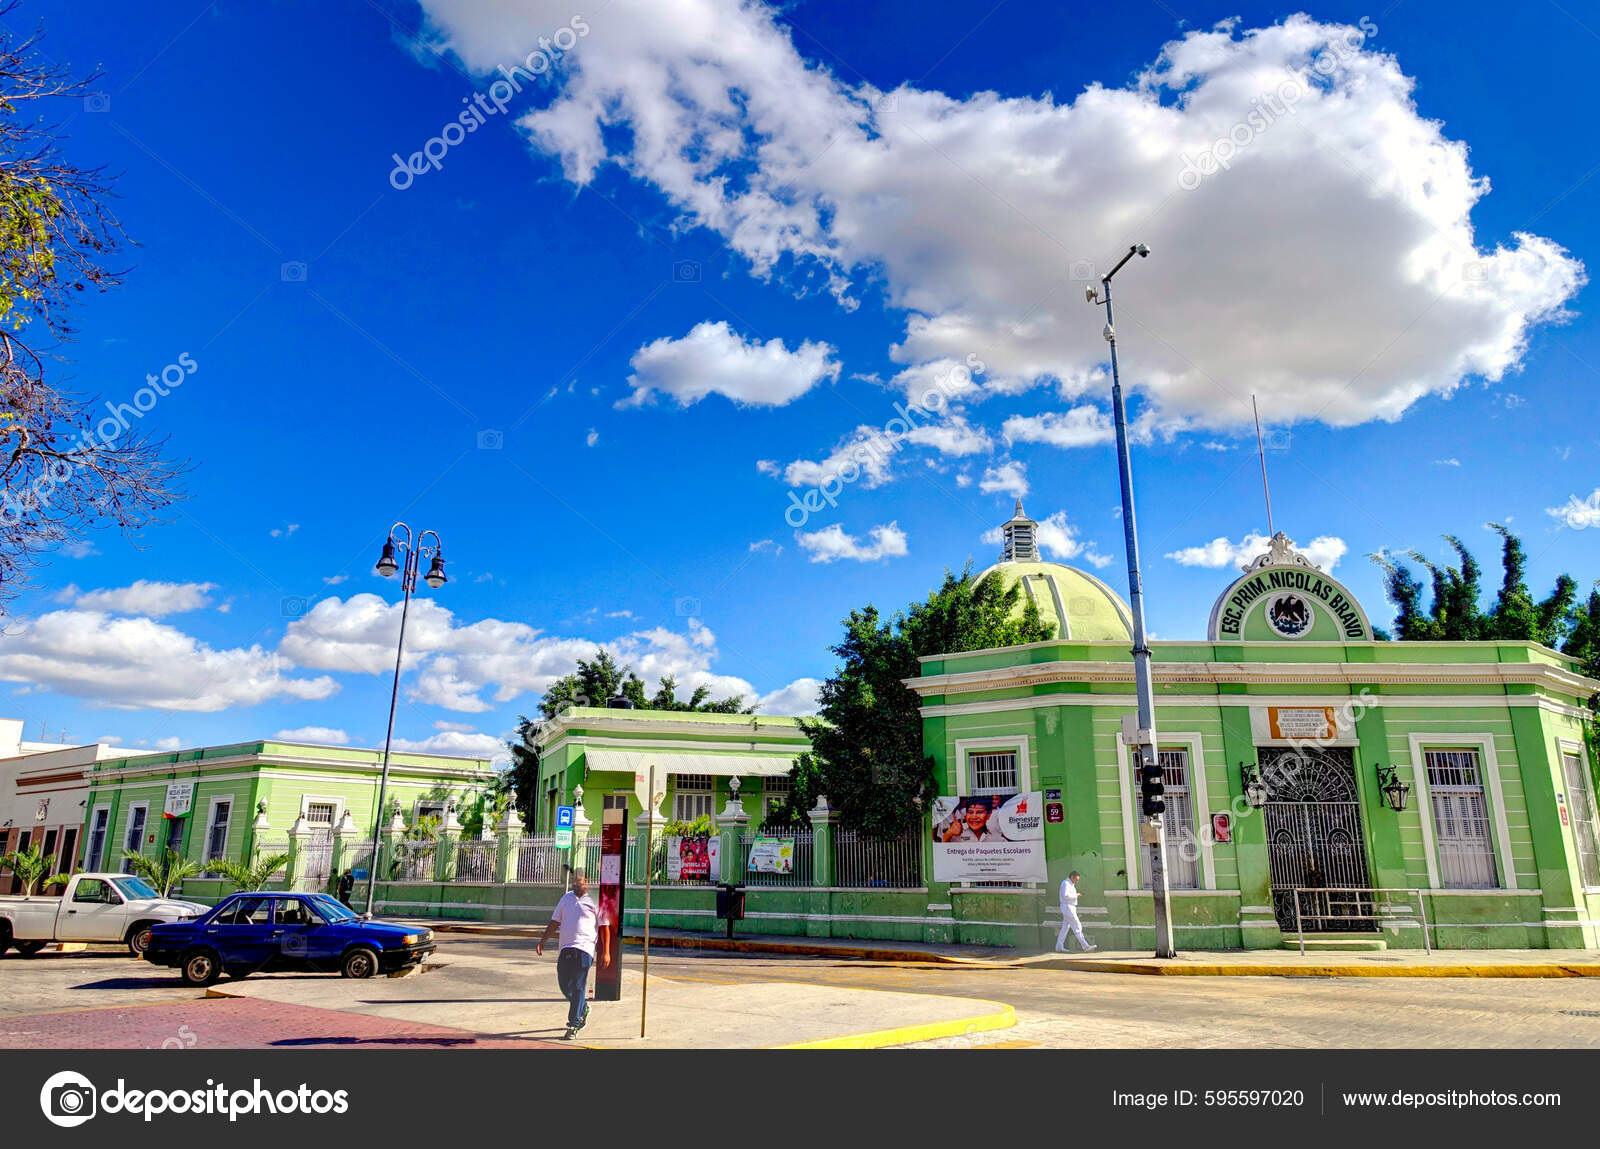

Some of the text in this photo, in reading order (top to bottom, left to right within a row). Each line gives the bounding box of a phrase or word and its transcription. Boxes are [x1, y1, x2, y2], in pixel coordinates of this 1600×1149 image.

[1221, 608, 1244, 634] ESC.
[1269, 571, 1332, 601] NICOLAS
[1328, 593, 1363, 638] BRAVO
[1050, 808, 1059, 816] 59
[1008, 816, 1040, 824] Bienestar
[946, 848, 968, 856] Entrega
[975, 848, 1002, 856] Paquetes
[1003, 847, 1031, 855] Escolares
